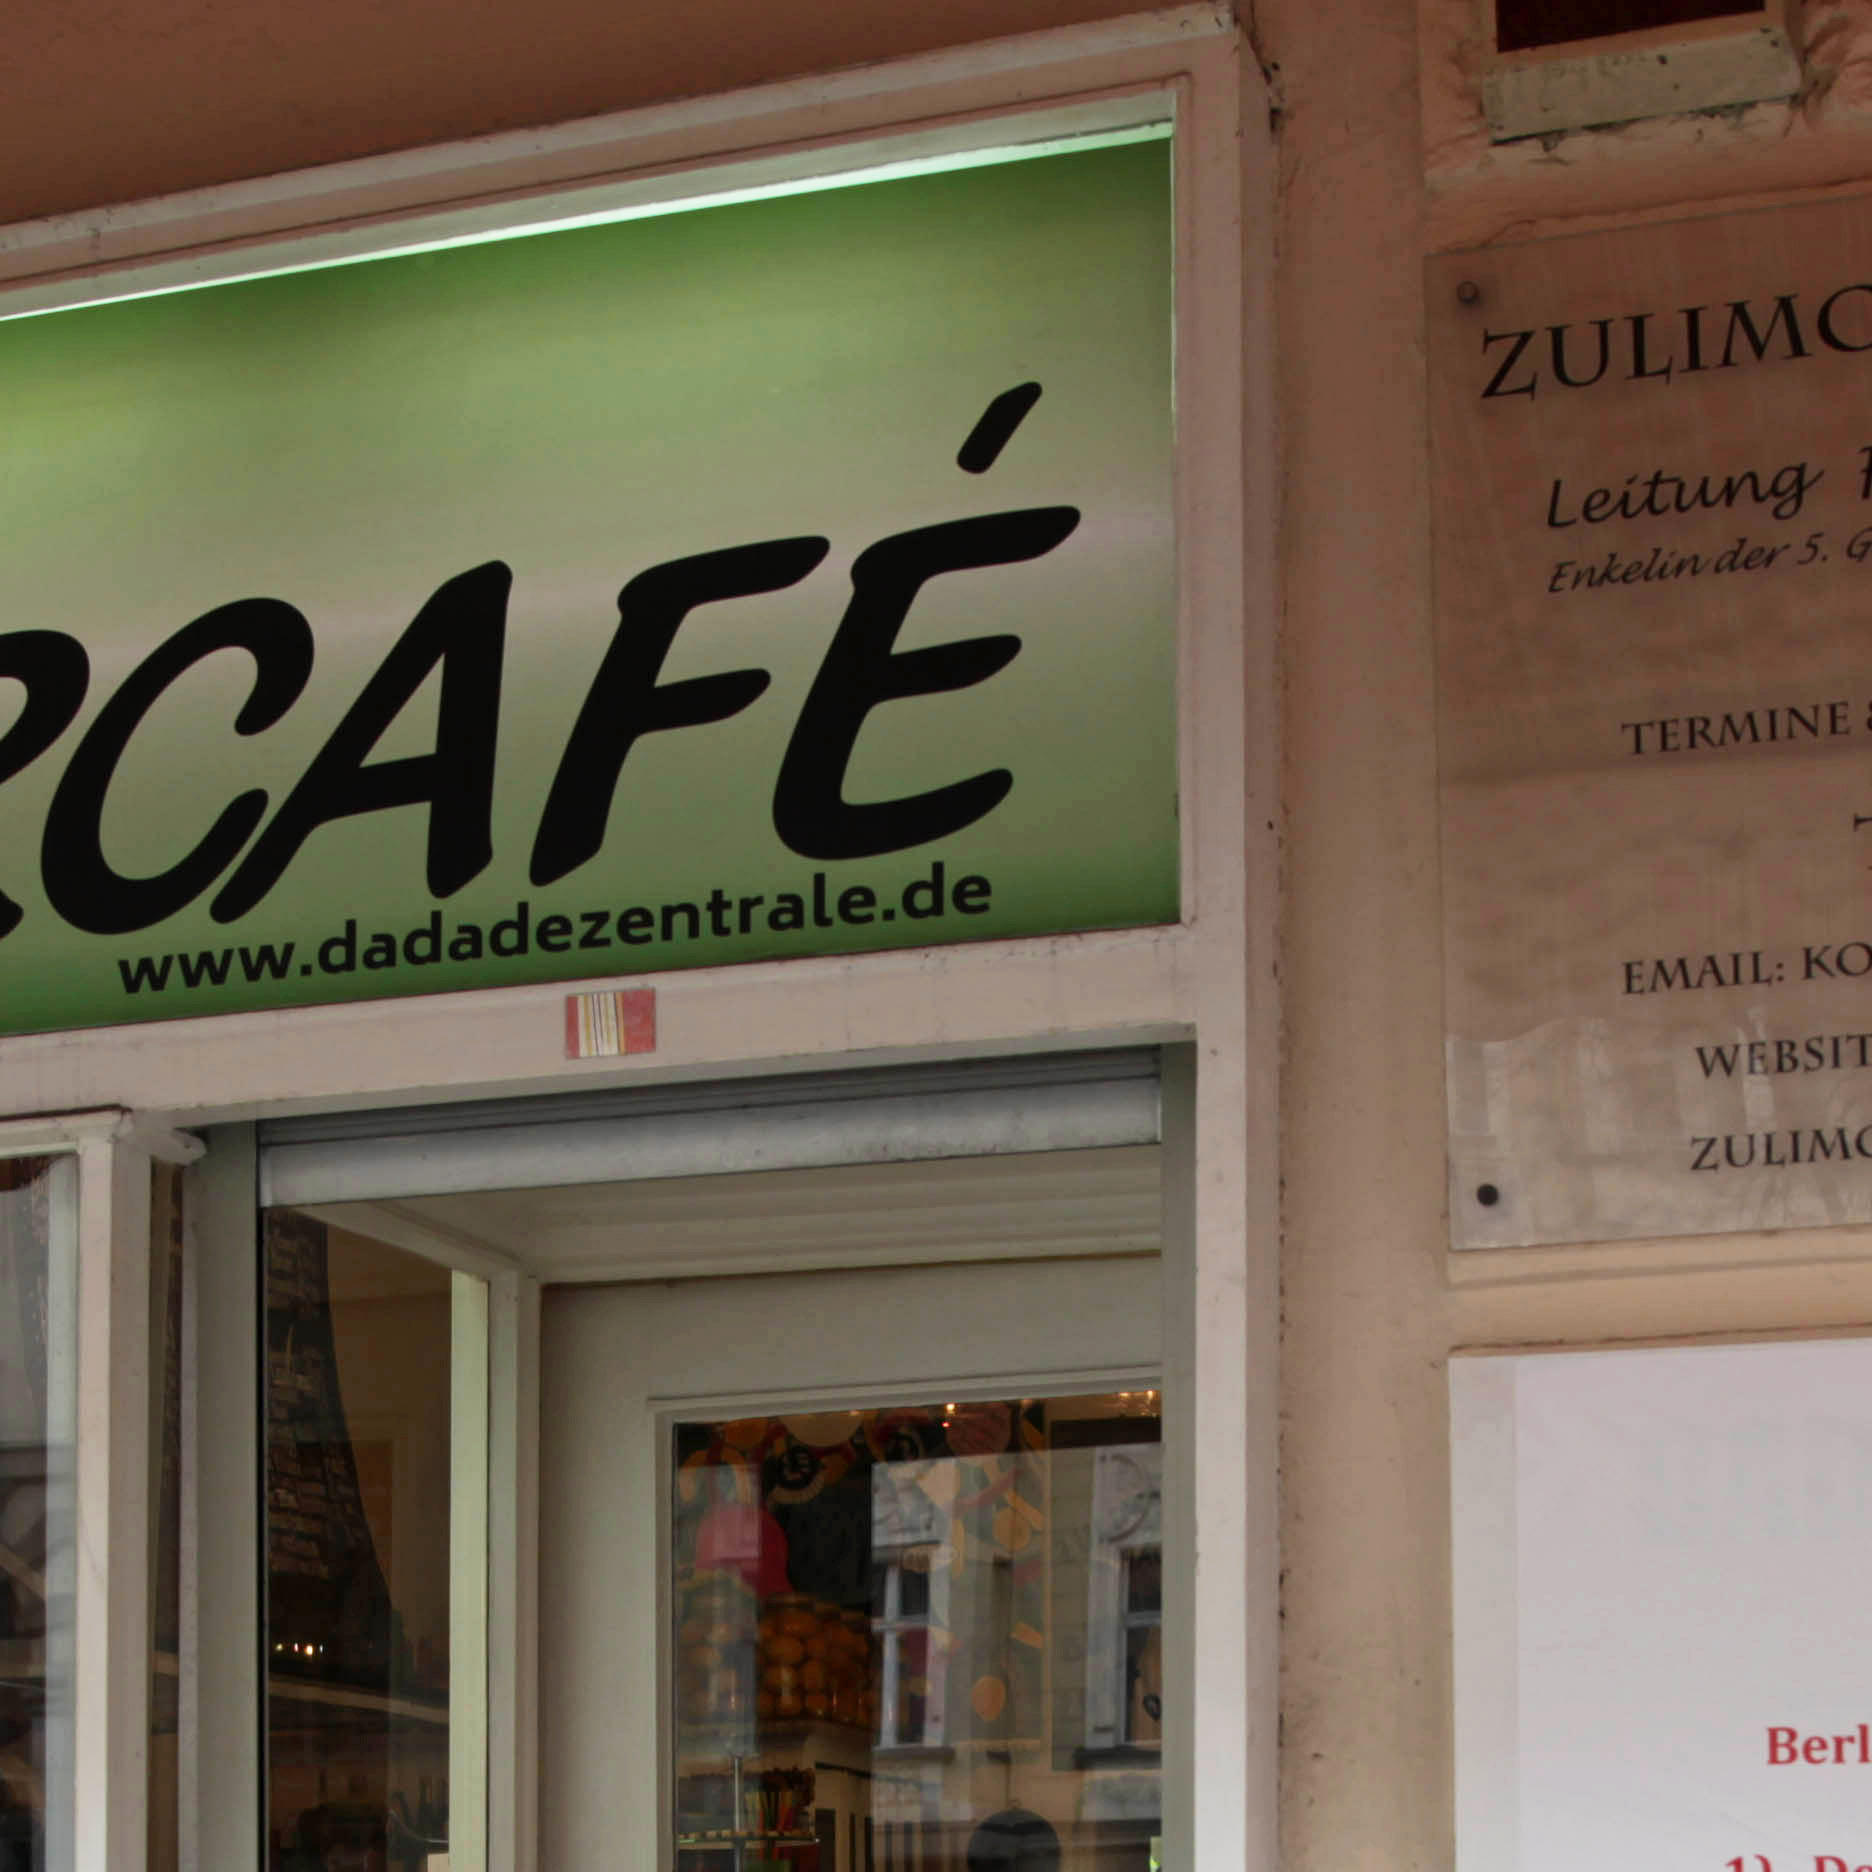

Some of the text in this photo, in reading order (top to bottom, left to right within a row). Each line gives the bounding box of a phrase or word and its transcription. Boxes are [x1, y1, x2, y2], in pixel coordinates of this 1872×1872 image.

[1545, 460, 1825, 530] Leitung
[1547, 545, 1714, 594] Enkelin
[1712, 536, 1790, 578] der
[1796, 530, 1829, 566] 5.
[1619, 699, 1850, 756] TERMINE
[117, 859, 995, 995] www.dadadezentrale.de
[1621, 950, 1785, 996] EMAIL:
